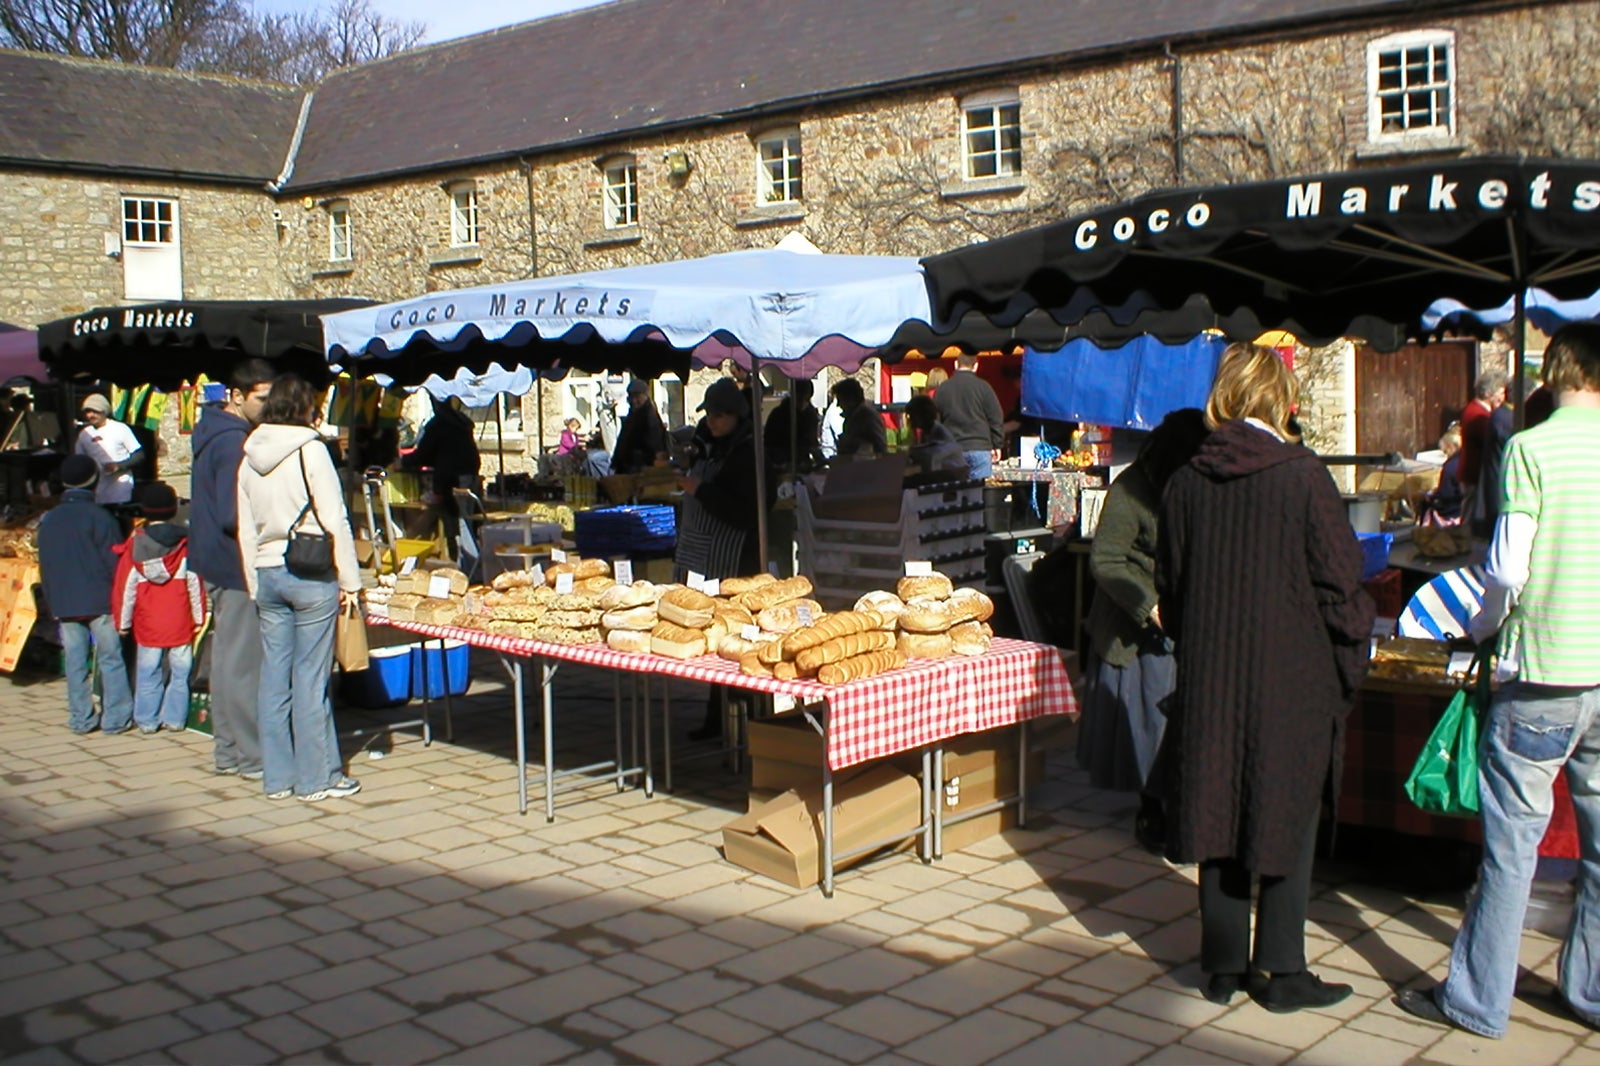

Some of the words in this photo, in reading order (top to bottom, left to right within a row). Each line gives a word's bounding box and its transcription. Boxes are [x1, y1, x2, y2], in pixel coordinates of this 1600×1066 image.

[1074, 202, 1211, 251] Coco
[1286, 170, 1600, 219] Markets
[73, 316, 109, 336] Coco
[123, 308, 194, 328] Markets
[390, 303, 456, 330] Coco
[489, 291, 632, 317] Markets
